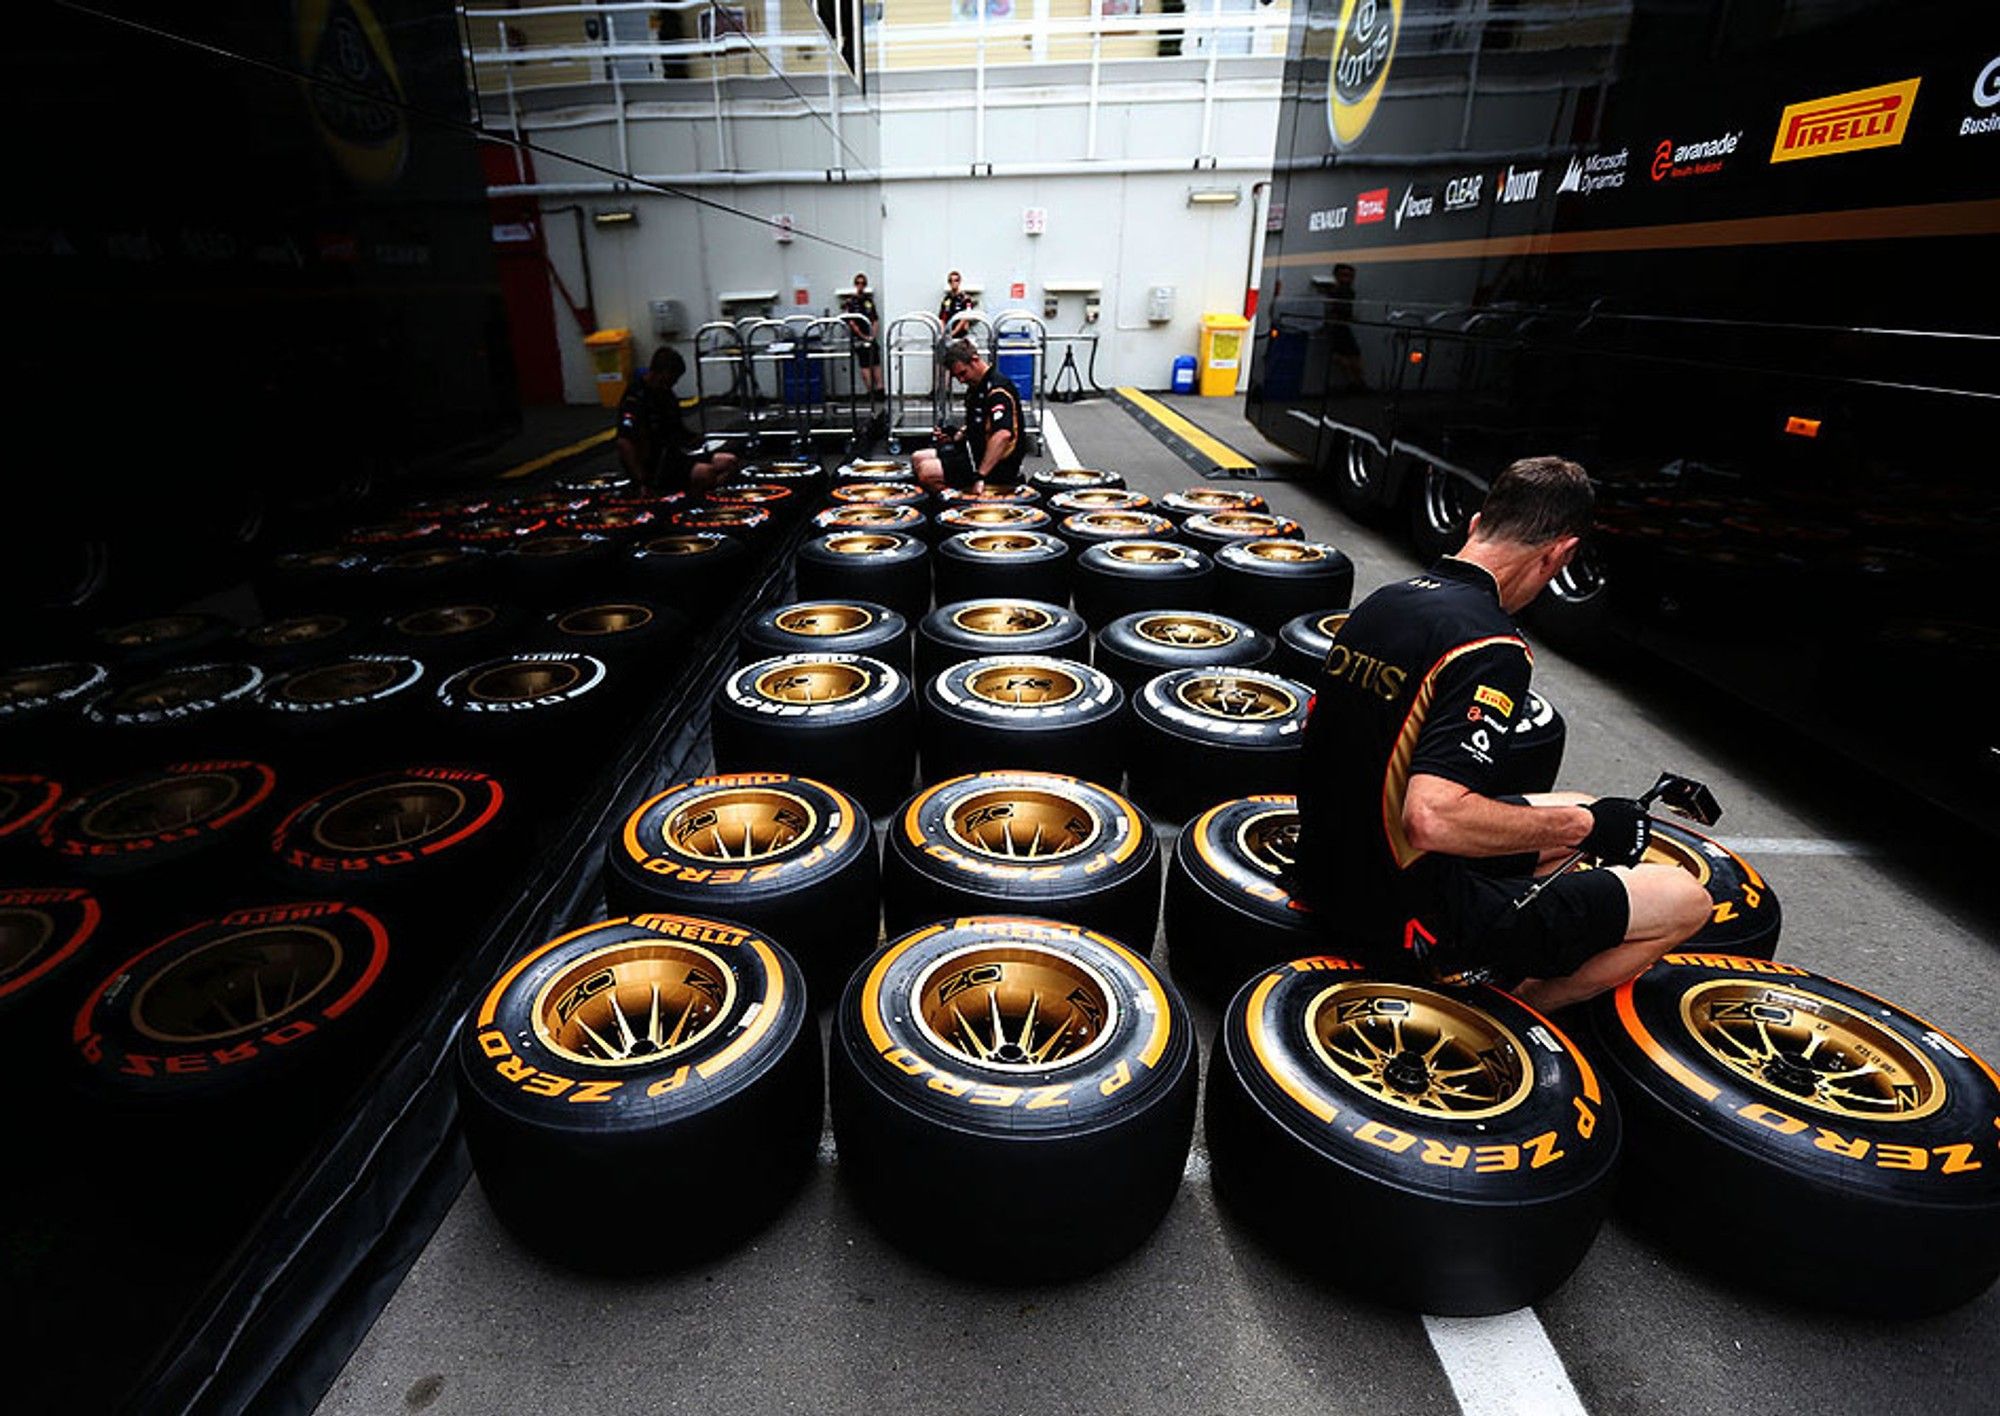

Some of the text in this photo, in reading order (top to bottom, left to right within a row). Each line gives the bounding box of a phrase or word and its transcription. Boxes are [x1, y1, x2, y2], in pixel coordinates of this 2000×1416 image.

[1338, 24, 1389, 87] LOTUS
[1783, 95, 1902, 150] PIRELLI
[1585, 148, 1628, 171] Microsoft
[1674, 131, 1739, 162] avanade
[1445, 175, 1483, 207] CLEAR
[1503, 165, 1542, 204] burn
[1581, 171, 1626, 195] Dynamics
[1309, 206, 1348, 232] RENAULT
[1326, 644, 1408, 700] OTUS
[643, 858, 783, 885] ZERO
[630, 913, 753, 947] PIRELLI
[1662, 953, 1811, 978] PIRELLI
[477, 1030, 692, 1103] P ZERO
[884, 1047, 1133, 1109] P ZERO
[1352, 1096, 1596, 1173] P ZERO
[1738, 1103, 1982, 1175] ZERO
